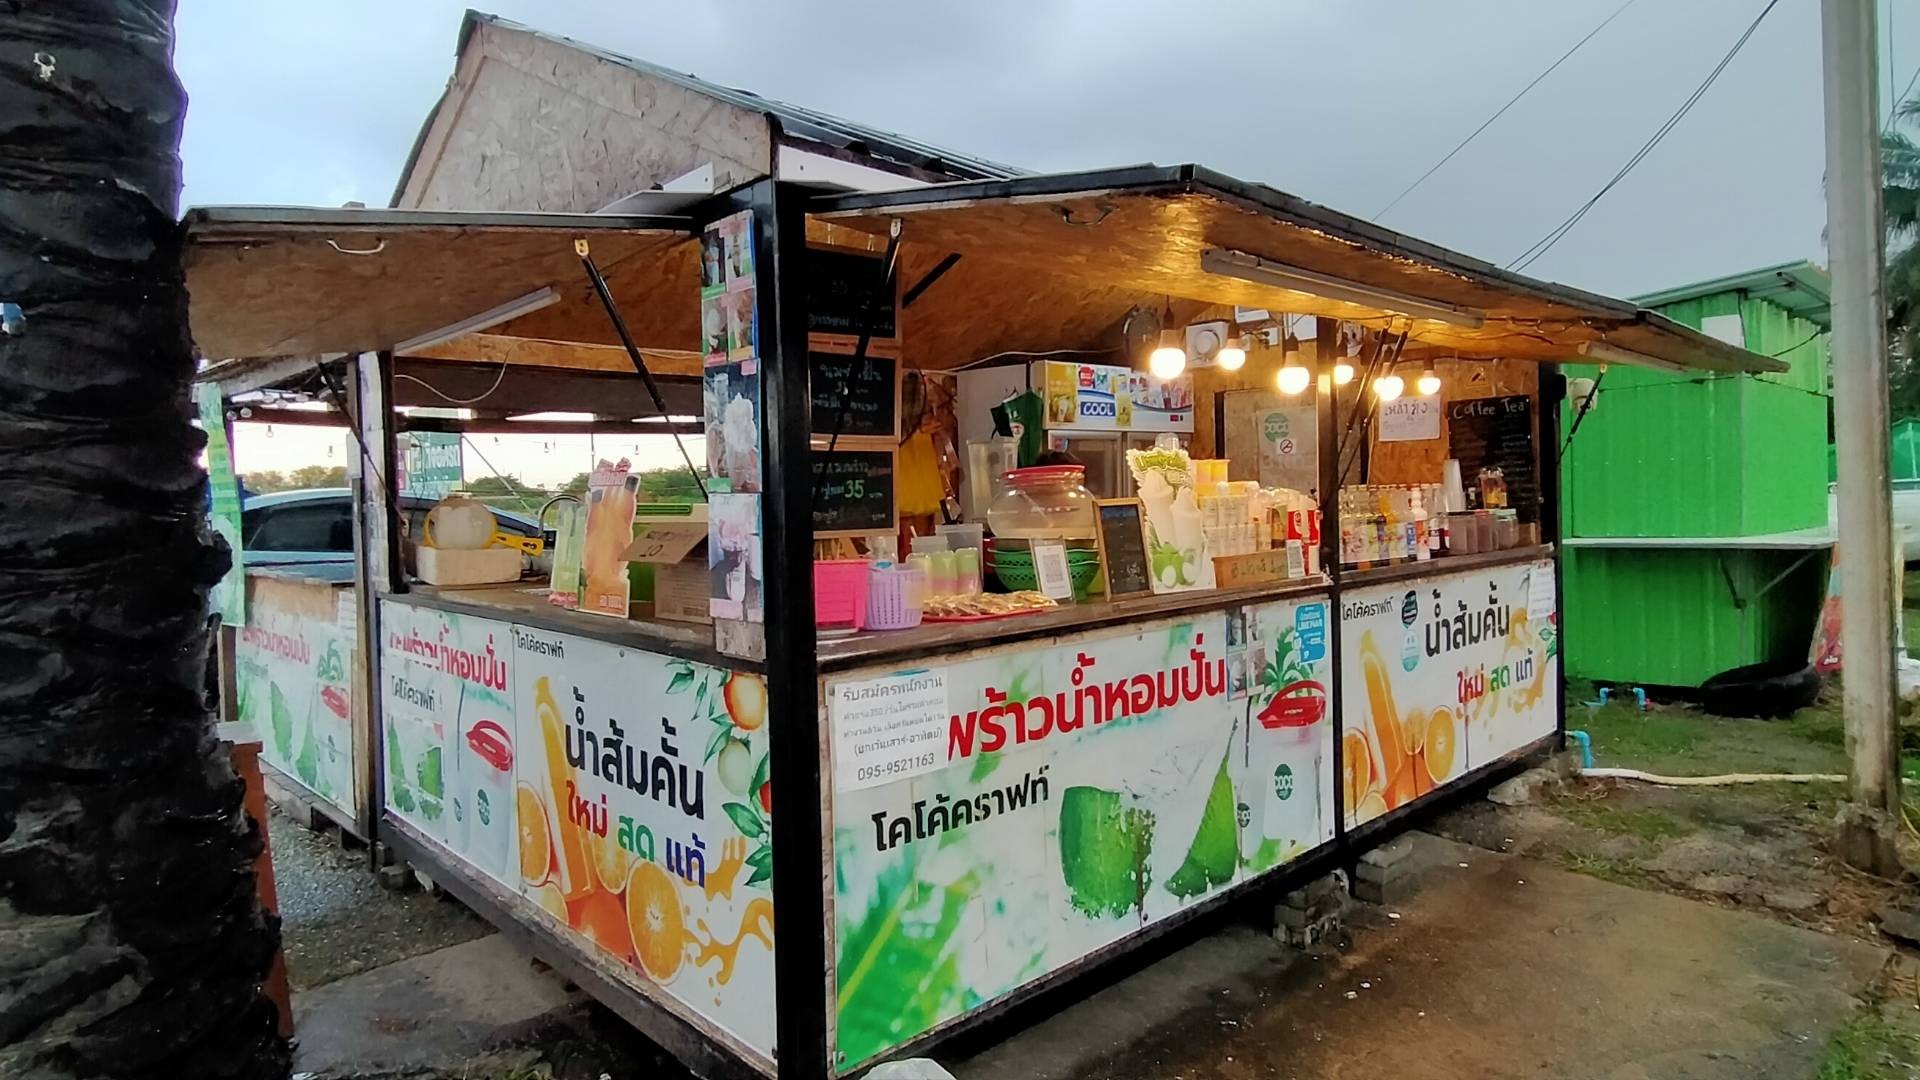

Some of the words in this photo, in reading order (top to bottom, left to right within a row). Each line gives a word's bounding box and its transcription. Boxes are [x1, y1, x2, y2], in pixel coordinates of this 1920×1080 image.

[1083, 402, 1113, 415] COOL
[1453, 401, 1496, 420] Coffee
[1501, 398, 1525, 413] Tea
[845, 479, 865, 499] 35
[1425, 581, 1510, 658] น้ำส้มคั้น
[1457, 663, 1484, 703] ใหม่
[1489, 664, 1511, 693] สด
[1515, 648, 1533, 683] แท้
[565, 686, 705, 821] น้ำส้มคั้น
[857, 752, 935, 781] 095-9521163
[566, 779, 608, 839] ใหม่
[617, 815, 655, 862] สด
[665, 832, 706, 889] แท้
[872, 765, 1050, 851] โคโค้คราฟท์
